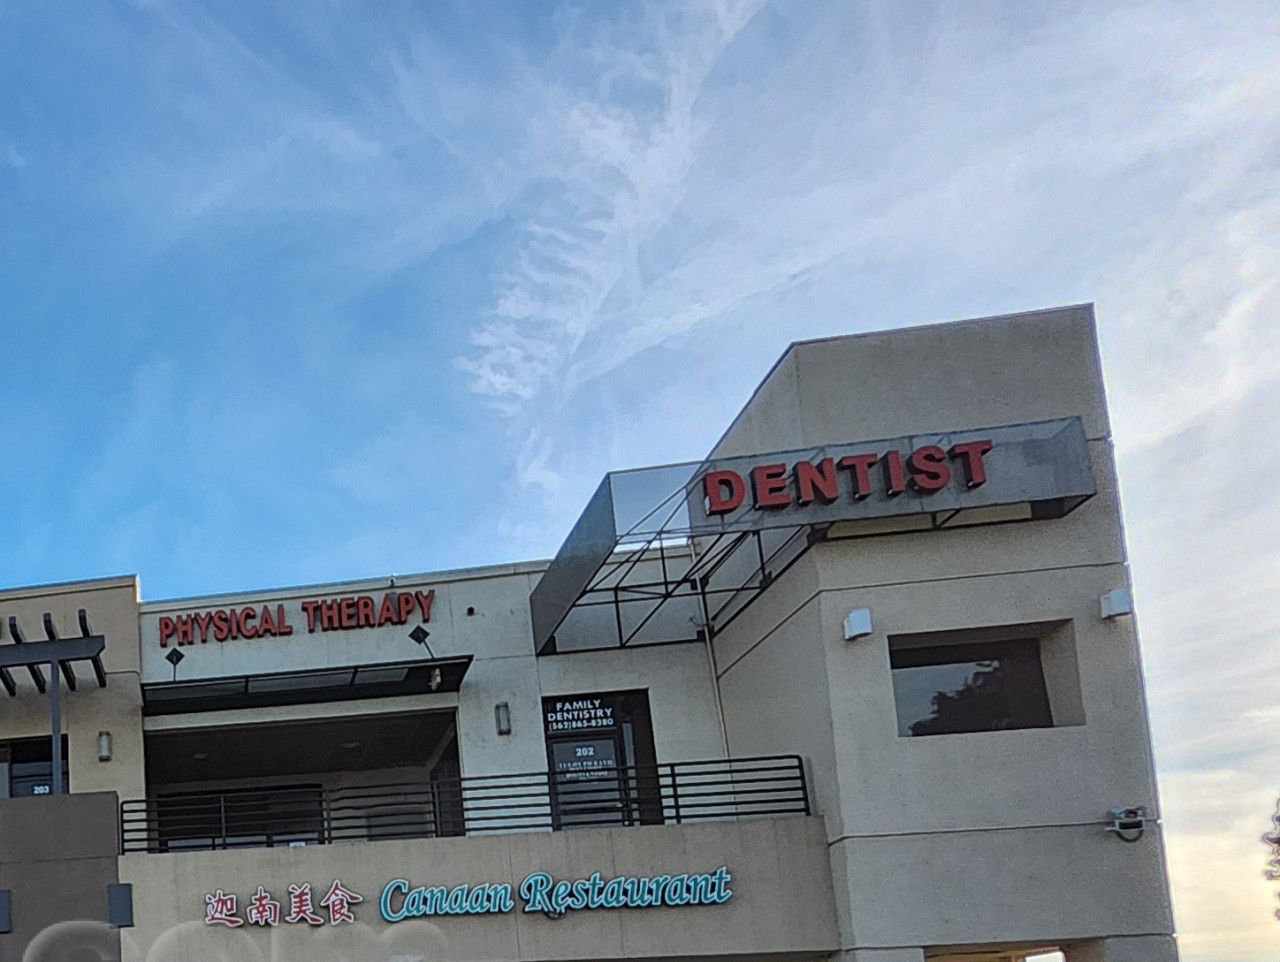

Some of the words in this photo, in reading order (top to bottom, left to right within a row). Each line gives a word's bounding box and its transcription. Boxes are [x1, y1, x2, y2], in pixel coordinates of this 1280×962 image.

[704, 440, 991, 515] DENTIST
[159, 604, 293, 648] PHYSICAL
[301, 589, 436, 633] THERAPY
[547, 708, 613, 721] DENTISTRY
[556, 699, 601, 711] FAMILY
[576, 747, 595, 757] 202
[33, 785, 50, 795] 203
[205, 879, 363, 927] 迦南美食
[380, 878, 515, 923] Canaan
[520, 866, 733, 915] Restaurant
